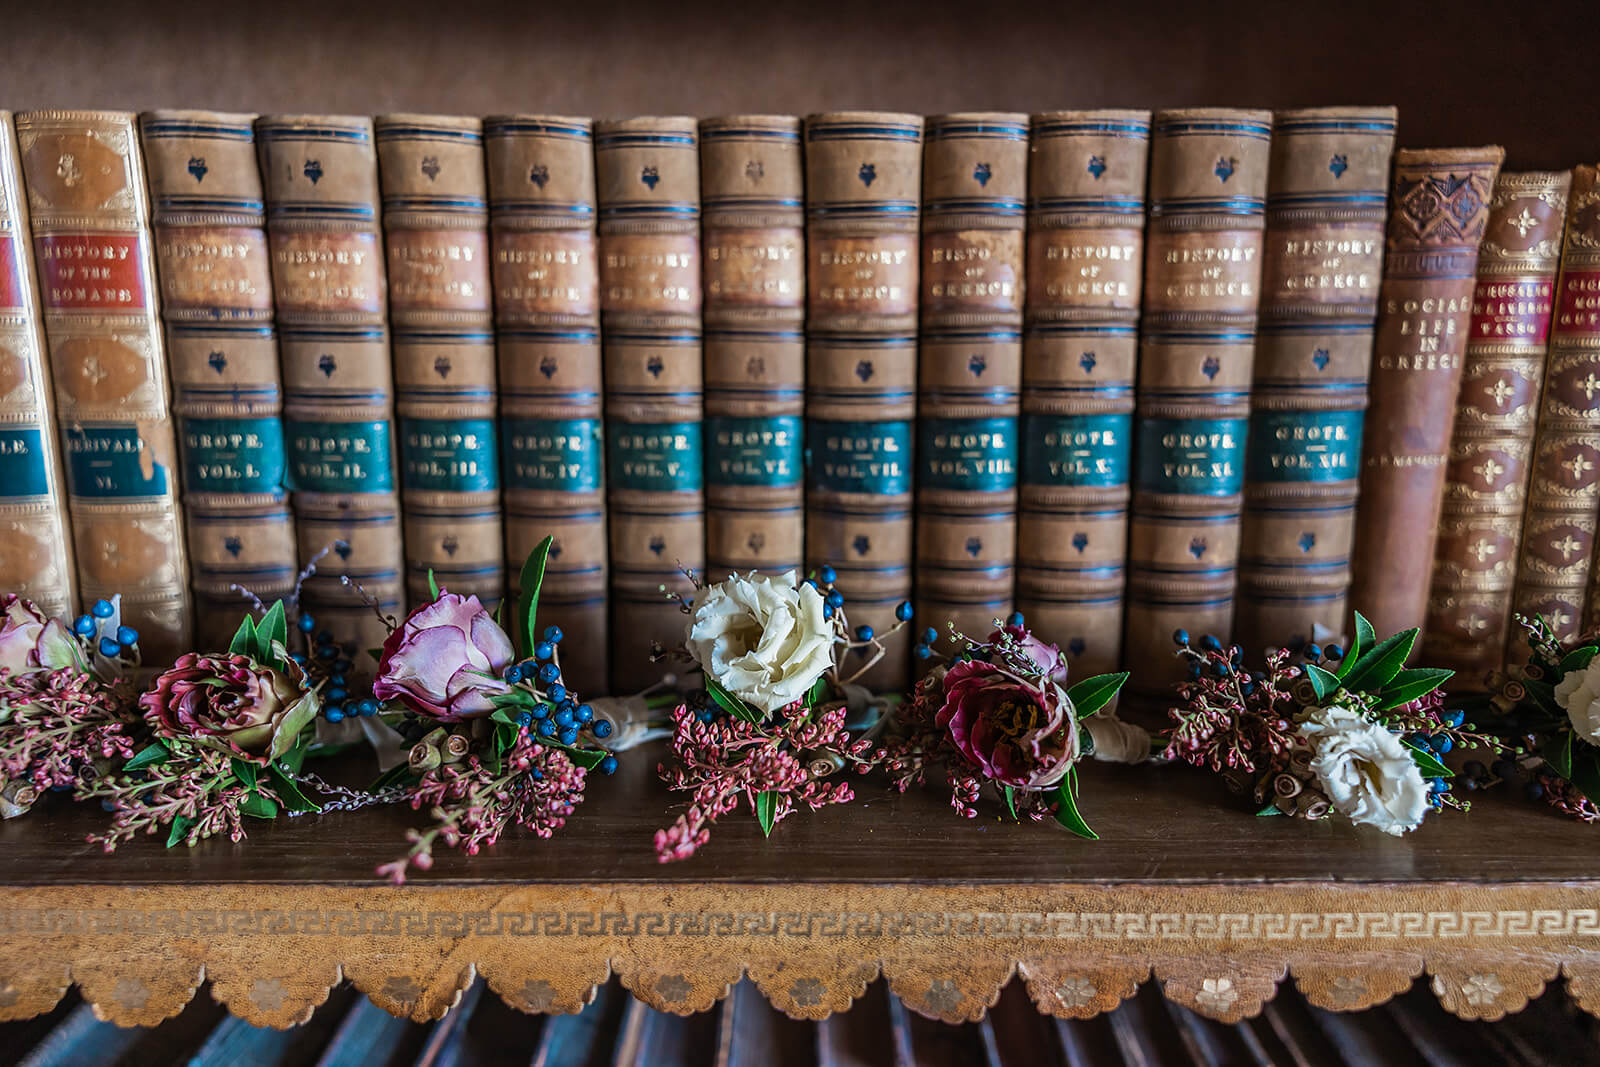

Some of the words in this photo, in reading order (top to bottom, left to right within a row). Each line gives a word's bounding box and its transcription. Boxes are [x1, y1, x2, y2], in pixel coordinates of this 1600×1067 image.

[43, 245, 129, 260] HISTORY
[932, 247, 991, 262] HISTO
[1047, 246, 1135, 260] HISTORY
[1166, 248, 1256, 263] HISTORY
[1286, 240, 1375, 256] HISTORY
[51, 287, 131, 302] ROMANS
[1387, 296, 1468, 313] SOCIAL
[1401, 319, 1456, 336] LIFE
[1420, 336, 1439, 352] IN
